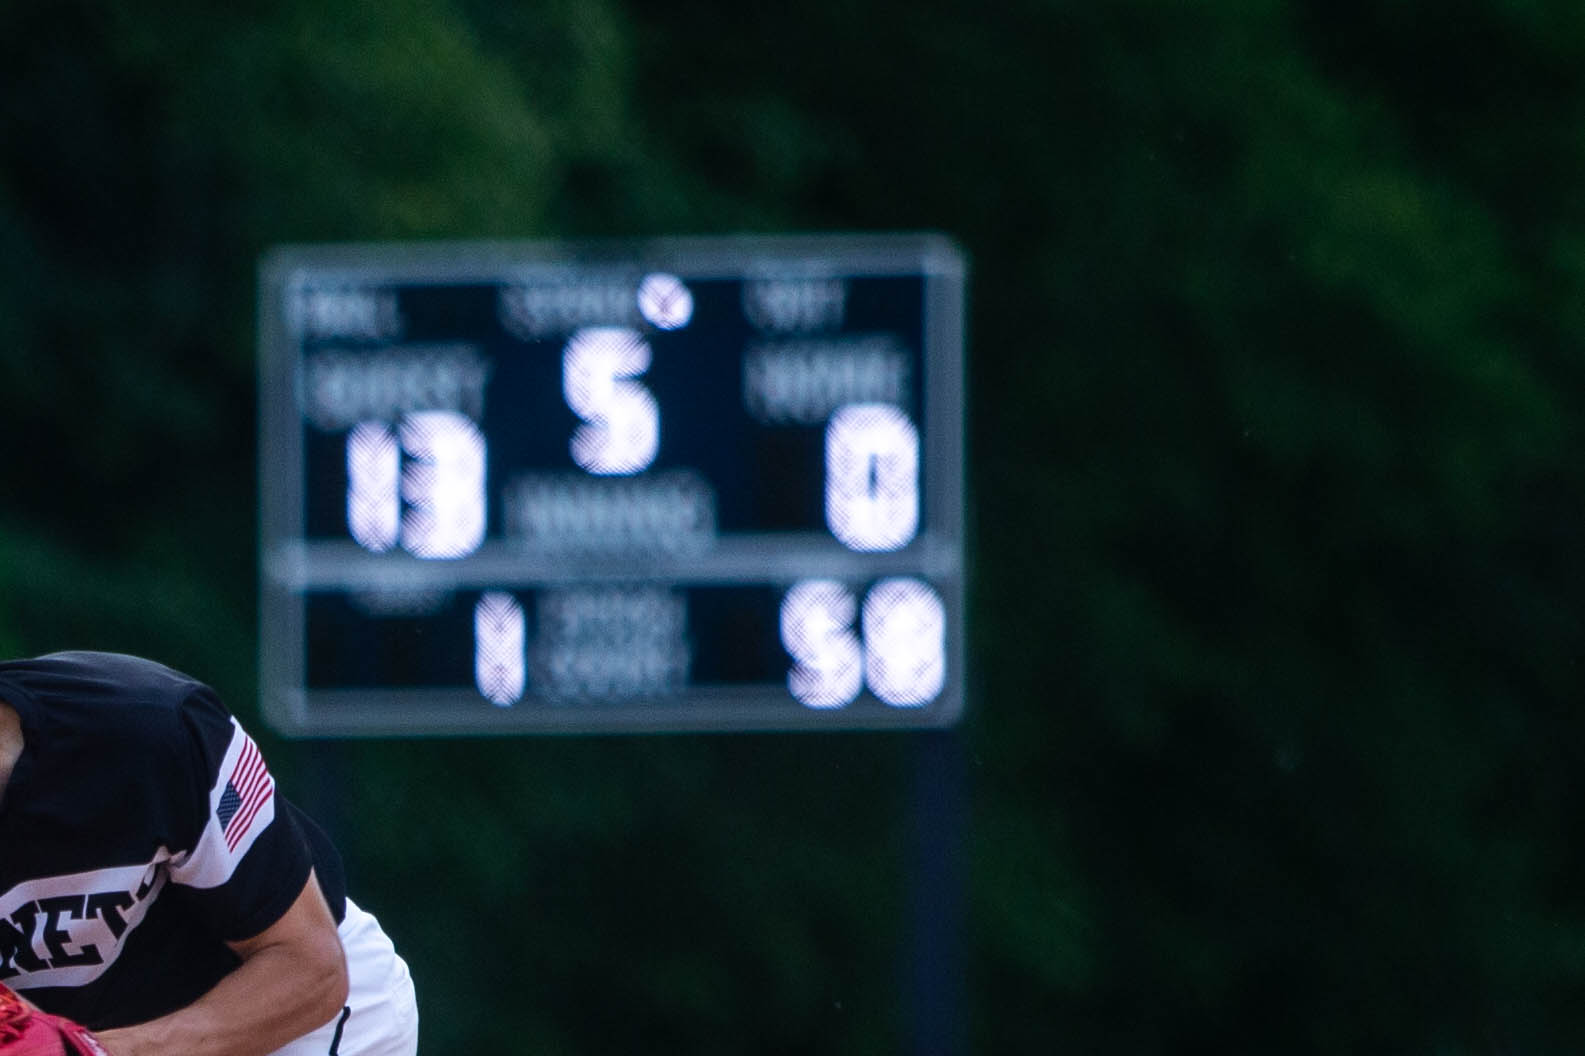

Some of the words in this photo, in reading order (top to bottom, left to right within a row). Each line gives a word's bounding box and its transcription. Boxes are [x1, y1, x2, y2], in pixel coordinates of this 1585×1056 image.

[563, 327, 660, 475] 5
[347, 411, 487, 560] 13
[824, 403, 920, 552] 0
